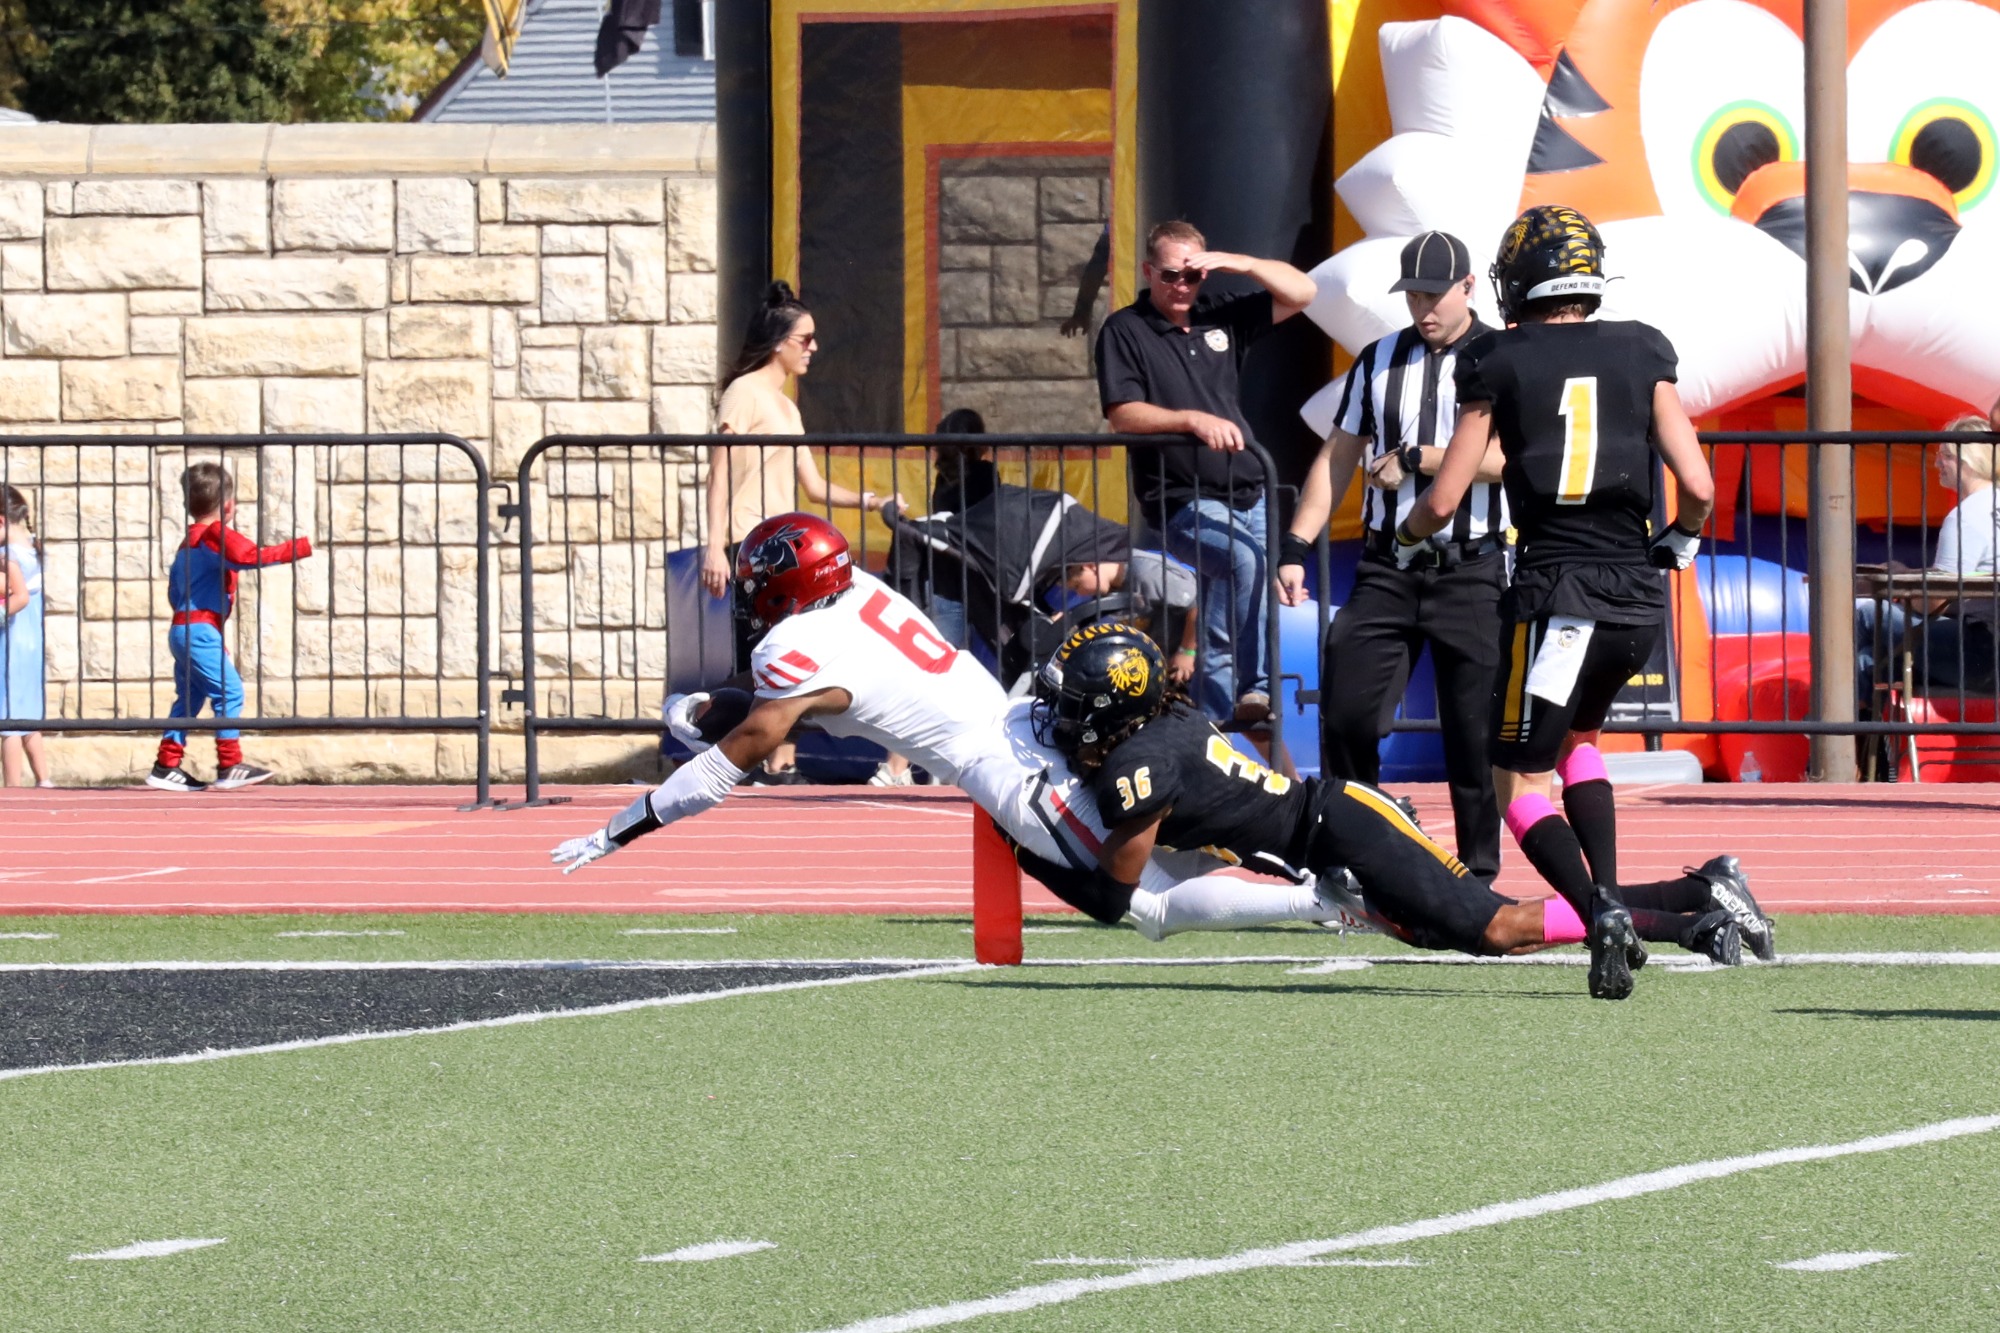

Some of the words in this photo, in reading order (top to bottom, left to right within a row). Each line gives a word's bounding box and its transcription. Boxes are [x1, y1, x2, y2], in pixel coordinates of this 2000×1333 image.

[1551, 282, 1578, 291] DEFEND
[1580, 281, 1591, 289] THE
[1556, 376, 1598, 506] 1
[859, 589, 958, 674] 6
[1116, 765, 1152, 811] 36
